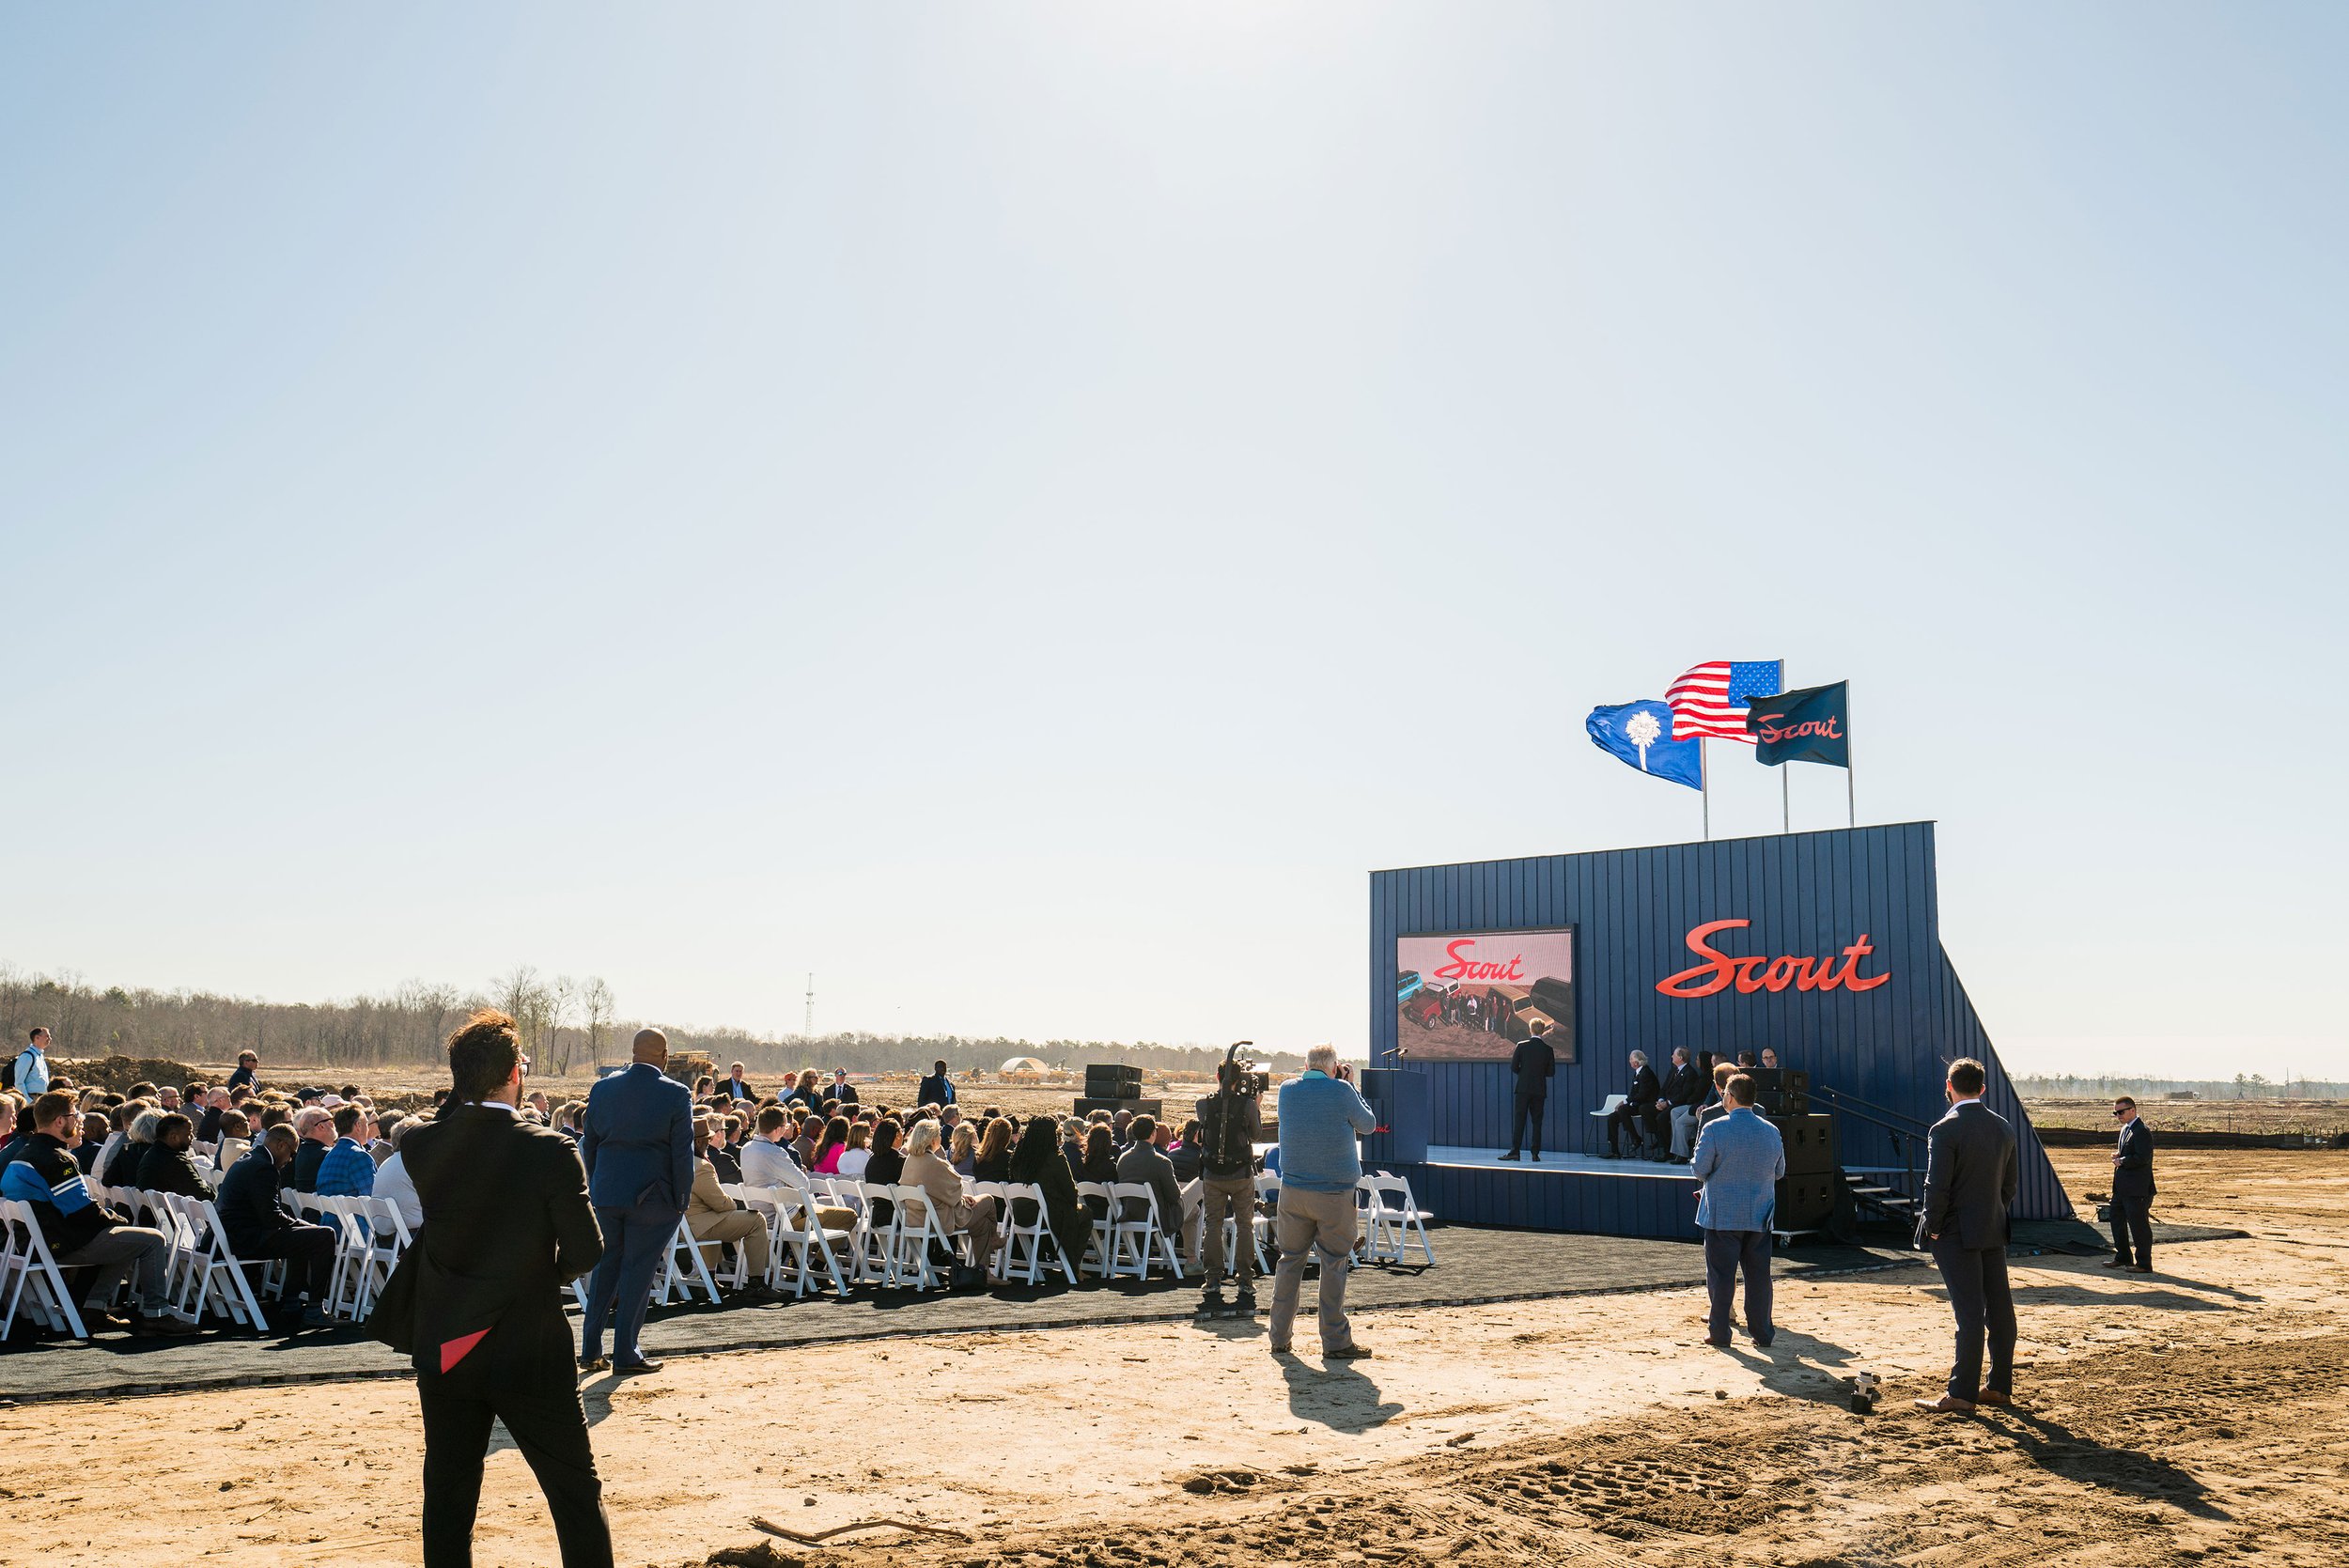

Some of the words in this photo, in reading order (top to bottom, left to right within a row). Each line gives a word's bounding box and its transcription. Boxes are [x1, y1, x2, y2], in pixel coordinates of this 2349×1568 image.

[1757, 713, 1843, 744] Scout
[1434, 939, 1524, 980] Scout
[1656, 919, 1891, 998] Scout
